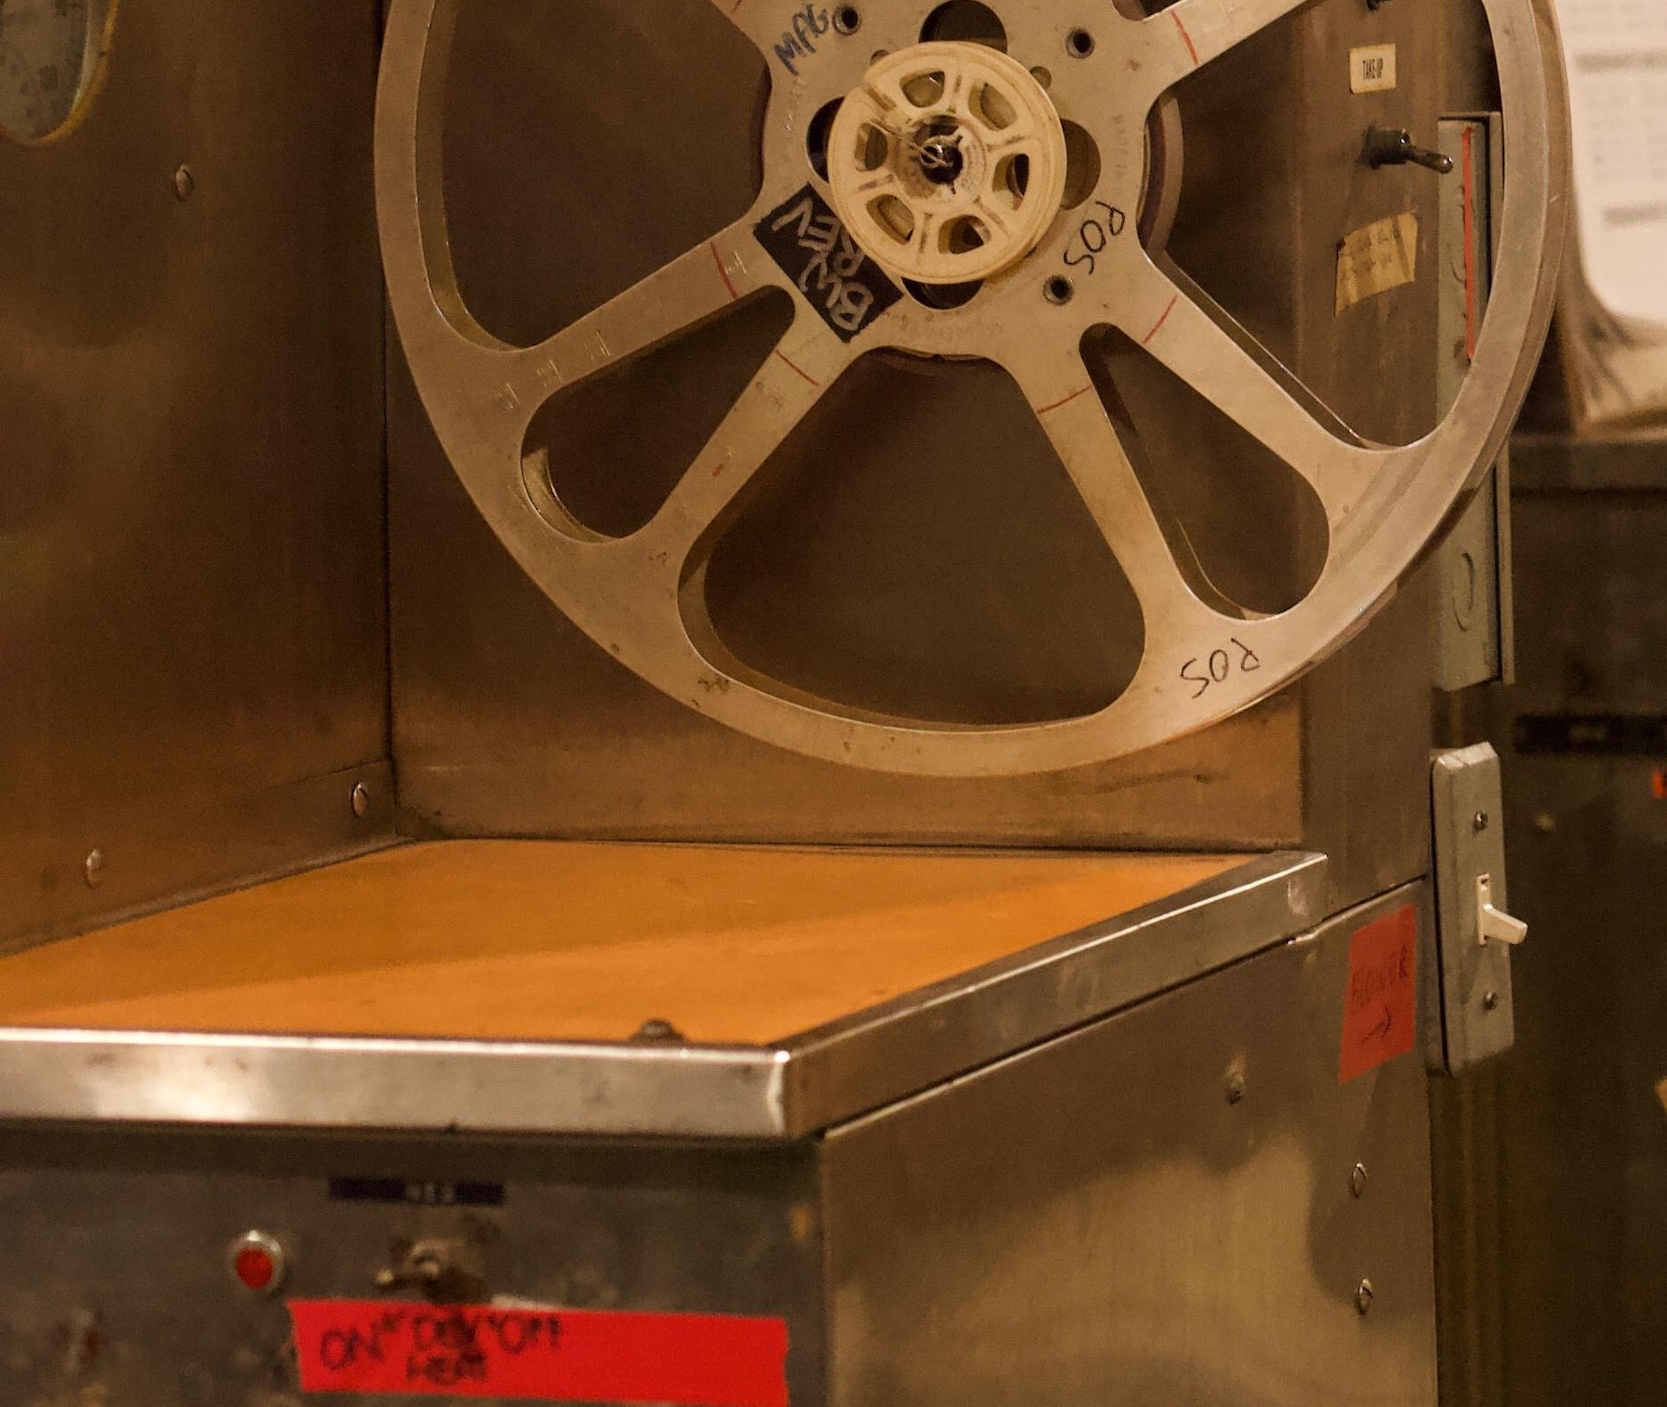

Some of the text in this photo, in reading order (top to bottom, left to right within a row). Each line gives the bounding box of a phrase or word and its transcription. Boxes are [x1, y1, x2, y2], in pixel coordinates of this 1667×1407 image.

[773, 3, 829, 76] MAG
[1064, 200, 1126, 275] POS
[1180, 637, 1262, 699] POS
